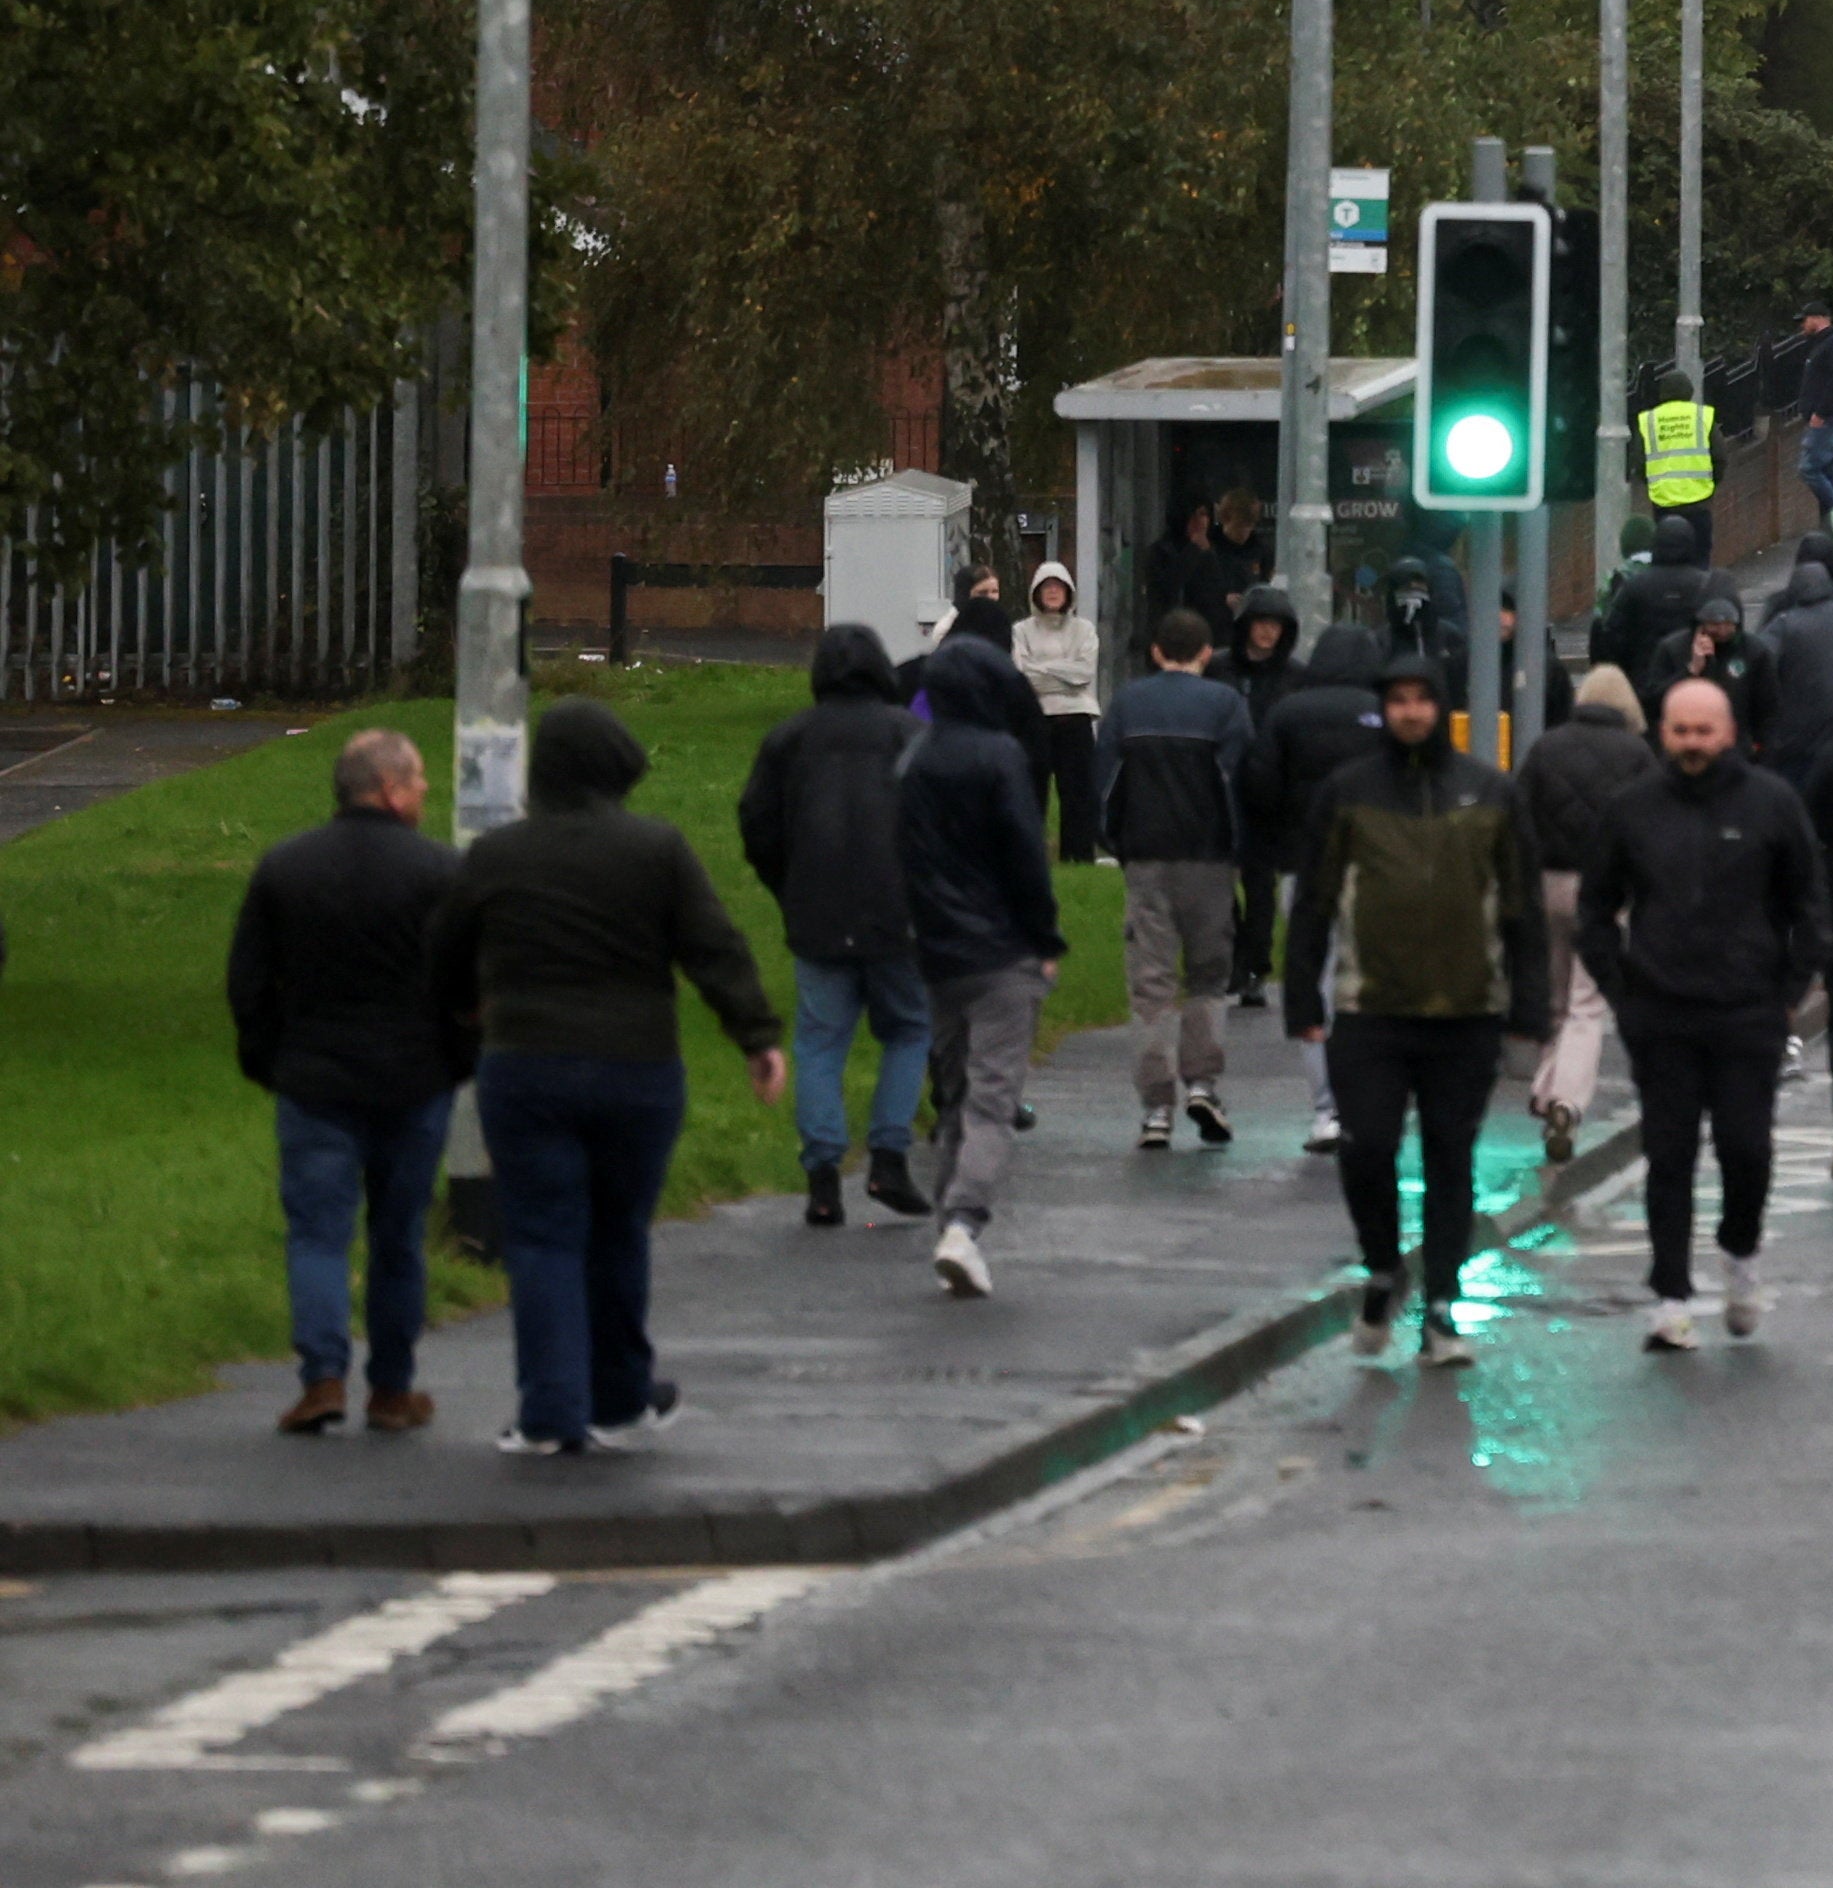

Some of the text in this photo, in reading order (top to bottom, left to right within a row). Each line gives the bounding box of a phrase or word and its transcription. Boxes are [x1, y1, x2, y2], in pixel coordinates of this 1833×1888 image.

[1660, 423, 1691, 432] Rights
[1658, 432, 1694, 442] Monitor
[1336, 501, 1400, 519] GROW
